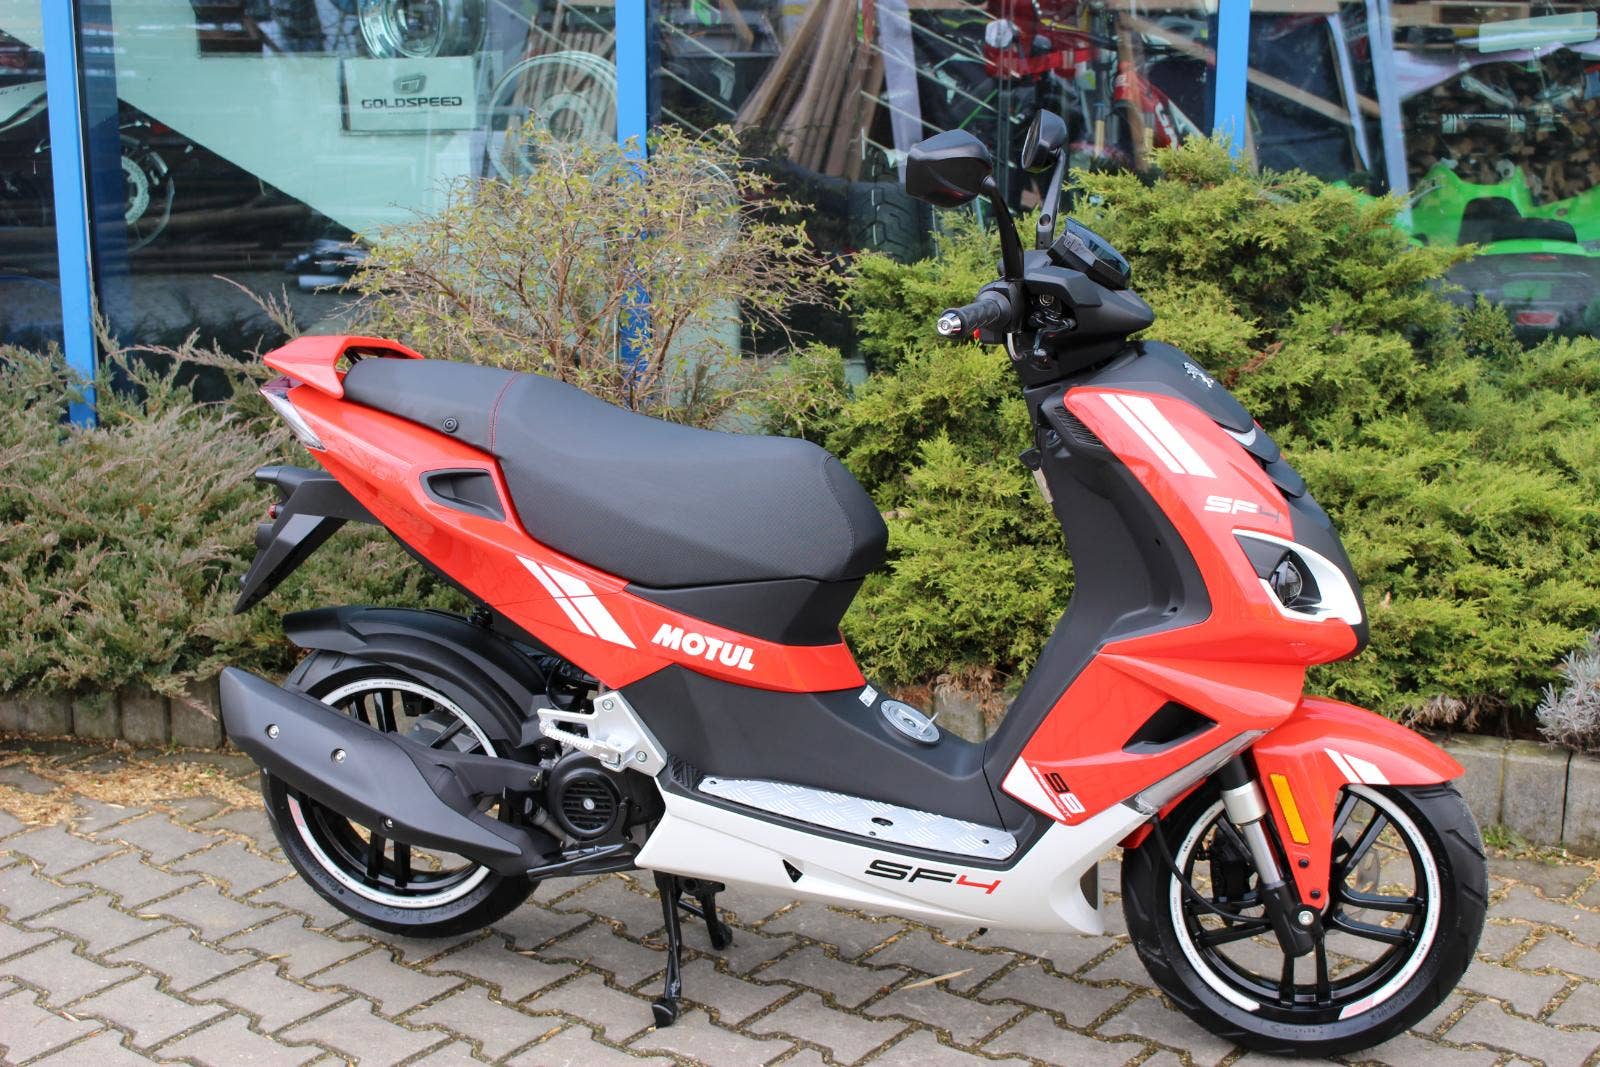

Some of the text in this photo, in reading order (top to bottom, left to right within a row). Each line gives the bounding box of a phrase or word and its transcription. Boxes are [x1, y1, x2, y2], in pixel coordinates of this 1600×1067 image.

[361, 96, 463, 110] GOLDSPEED
[1203, 495, 1280, 524] SF4
[650, 623, 755, 671] MOTUL
[864, 859, 1002, 895] SF4
